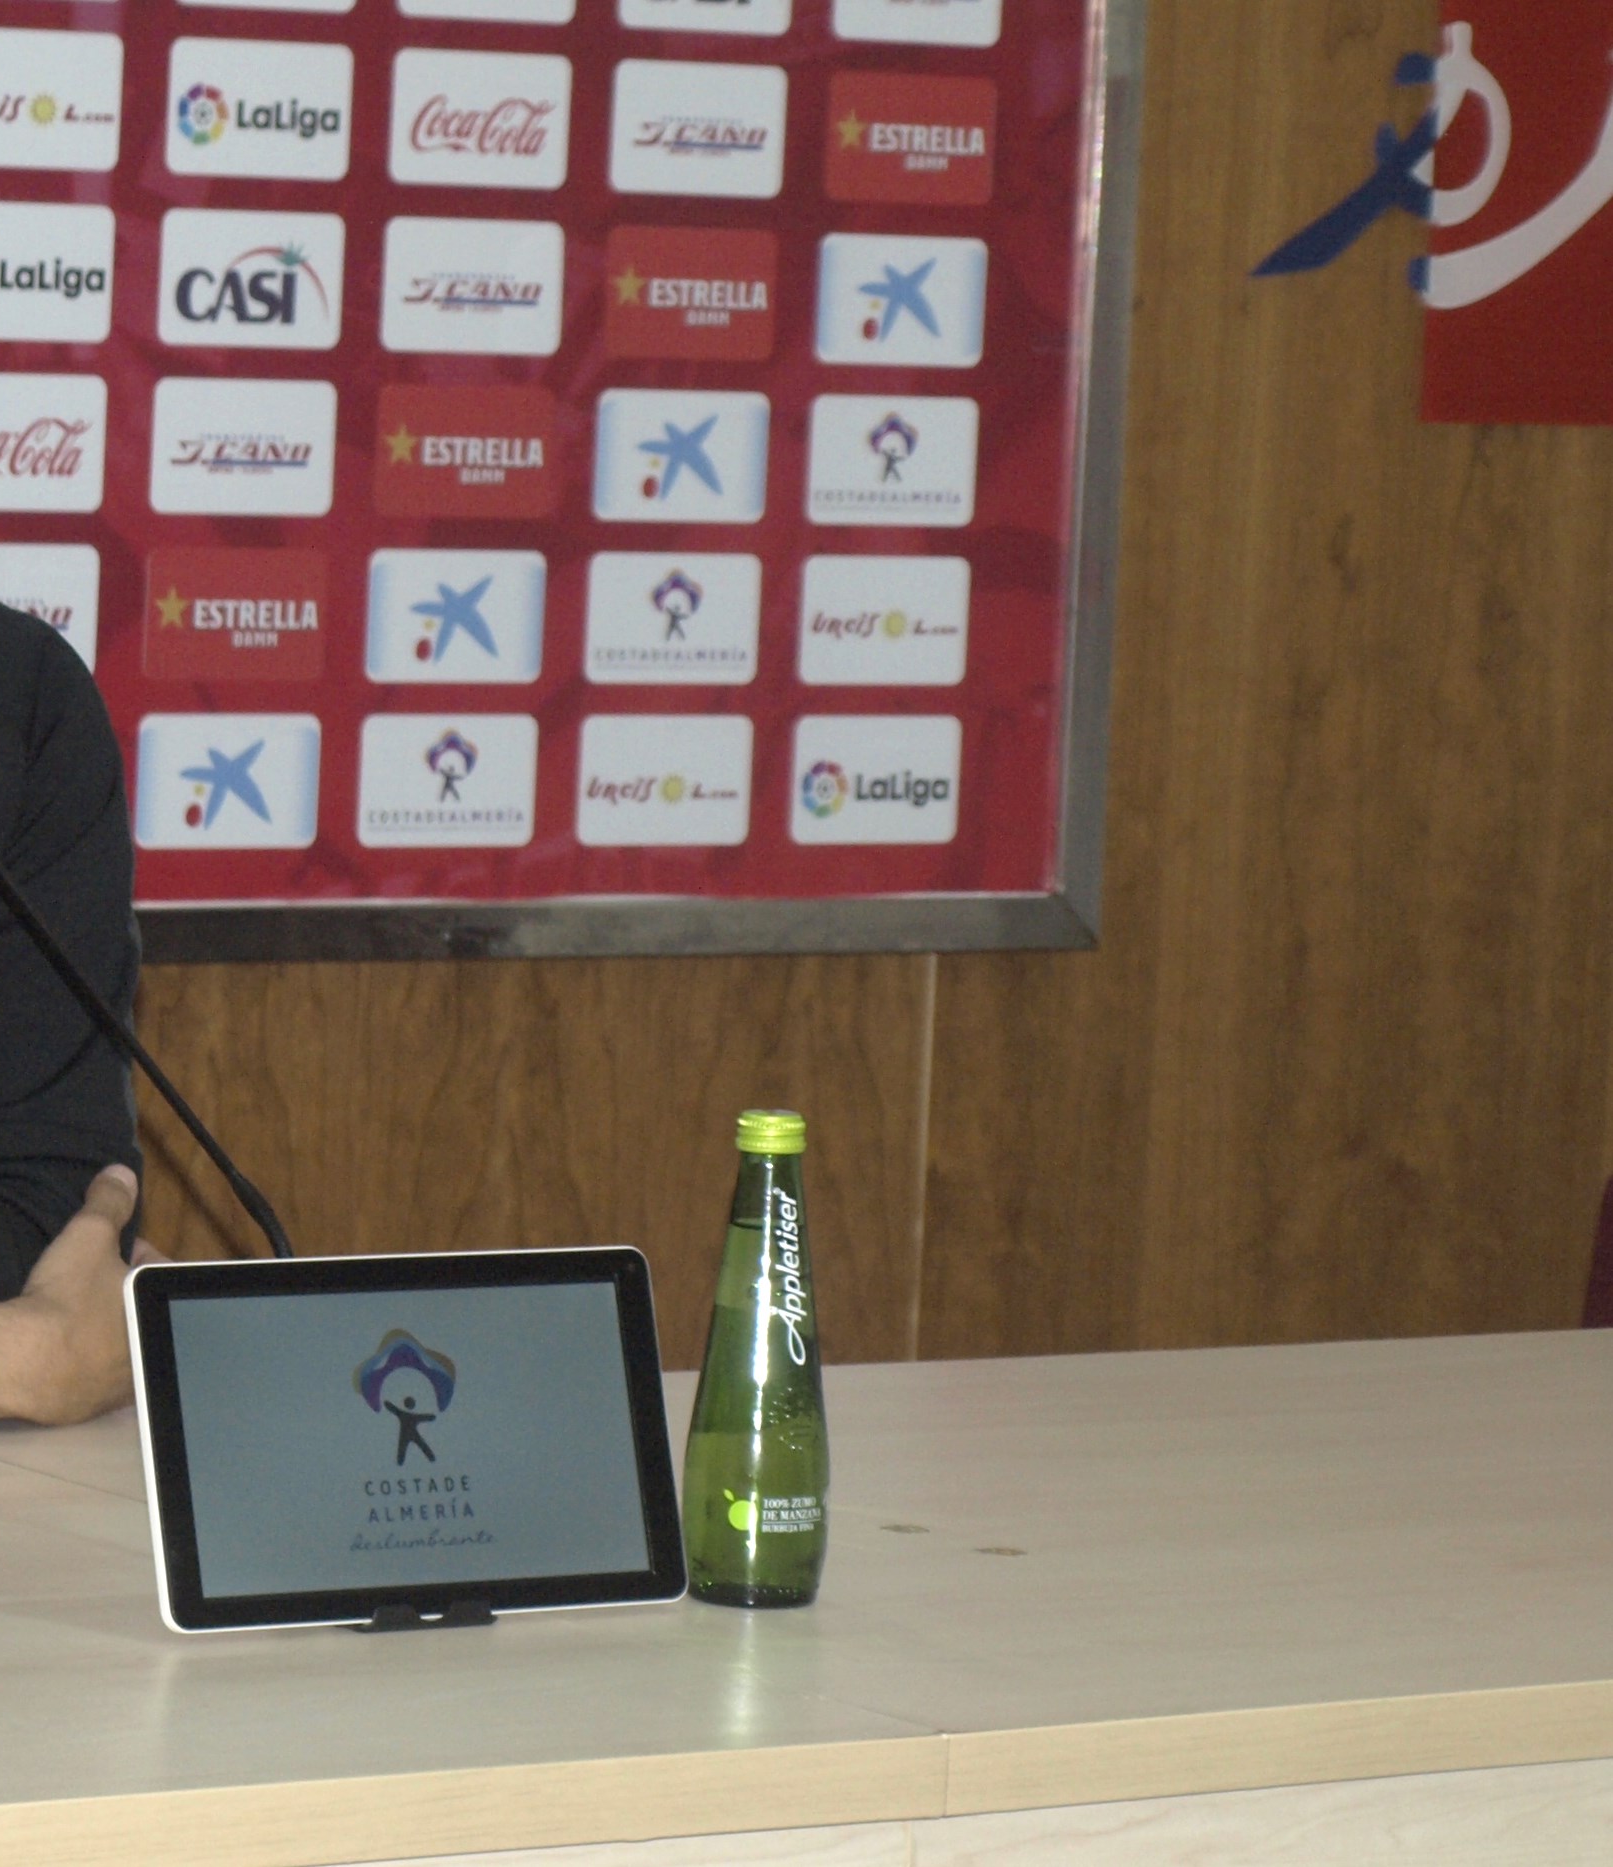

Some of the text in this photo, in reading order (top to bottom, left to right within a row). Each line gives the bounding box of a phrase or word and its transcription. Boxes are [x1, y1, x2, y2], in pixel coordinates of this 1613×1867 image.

[237, 99, 341, 138] LaLiga
[410, 93, 557, 157] Coca-Cola
[869, 122, 985, 156] ESTRELLA
[0, 259, 106, 299] LaLiga
[174, 267, 298, 325] CASI
[649, 277, 768, 311] ESTRELLA
[422, 436, 544, 468] ESTRELLA
[193, 600, 318, 630] ESTRELLA
[232, 631, 278, 648] DAMM
[854, 773, 950, 807] LaLiga
[773, 1190, 807, 1366] Appletiser
[368, 1498, 475, 1524] ALMERÍA
[762, 1509, 779, 1521] DE
